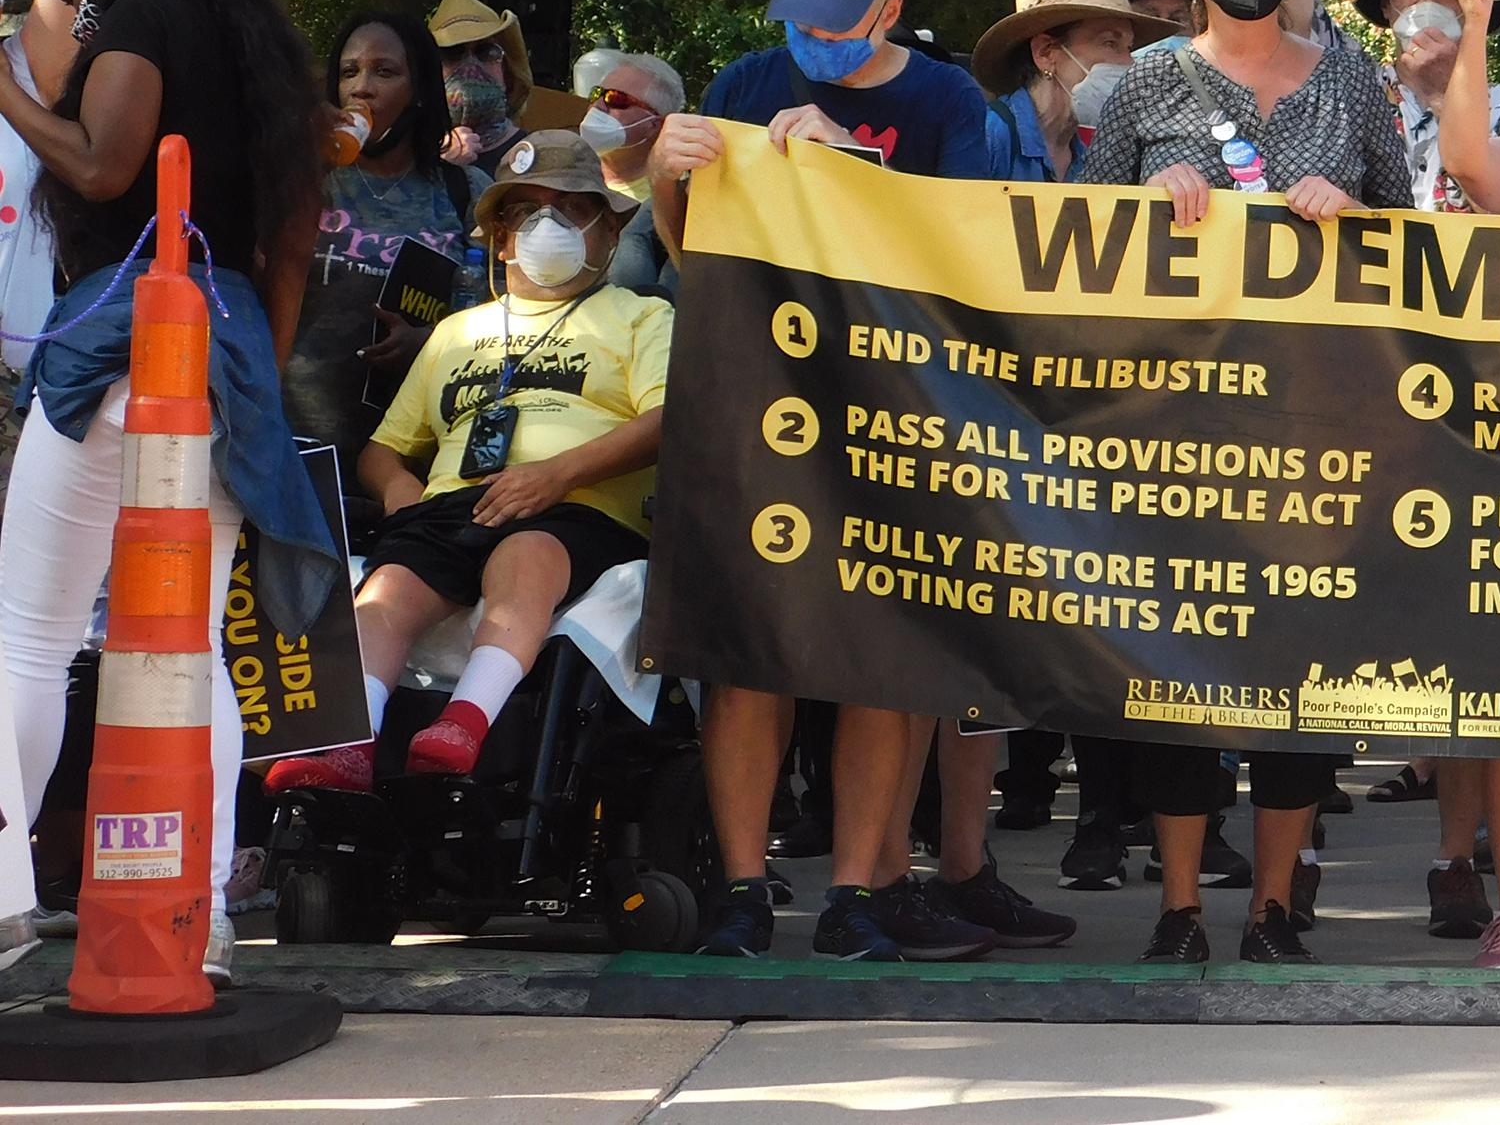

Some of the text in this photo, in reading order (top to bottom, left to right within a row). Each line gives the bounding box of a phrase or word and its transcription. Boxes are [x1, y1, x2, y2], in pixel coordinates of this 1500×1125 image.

[1010, 195, 1199, 298] WE
[346, 261, 354, 272] 1
[400, 284, 449, 323] WHIC
[474, 334, 574, 352] WE ARE THE
[849, 325, 931, 364] END
[943, 339, 1019, 382] THE
[1032, 356, 1268, 396] FILIBUSTER
[1410, 373, 1439, 409] 4
[775, 405, 1372, 483] 2 PASS ALL PROVISIONS OF
[846, 445, 1361, 526] THE FOR THE PEOPLE ACT
[1407, 500, 1437, 540] 5
[765, 514, 1358, 599] 3 FULLY RESTORE THE 1965
[837, 559, 1256, 638] VOTING RIGHTS ACT
[225, 560, 272, 736] YOU ON?
[1127, 678, 1290, 711] REPAIRERS
[1302, 700, 1448, 719] Poor People's Campaign
[1128, 704, 1288, 726] OF THE BREACH
[1298, 718, 1452, 733] A NATIONAL CALL for MORAL REVIVAL
[1462, 724, 1479, 733] FOR
[96, 816, 180, 849] TRP
[100, 867, 174, 879] 512-990-9525
